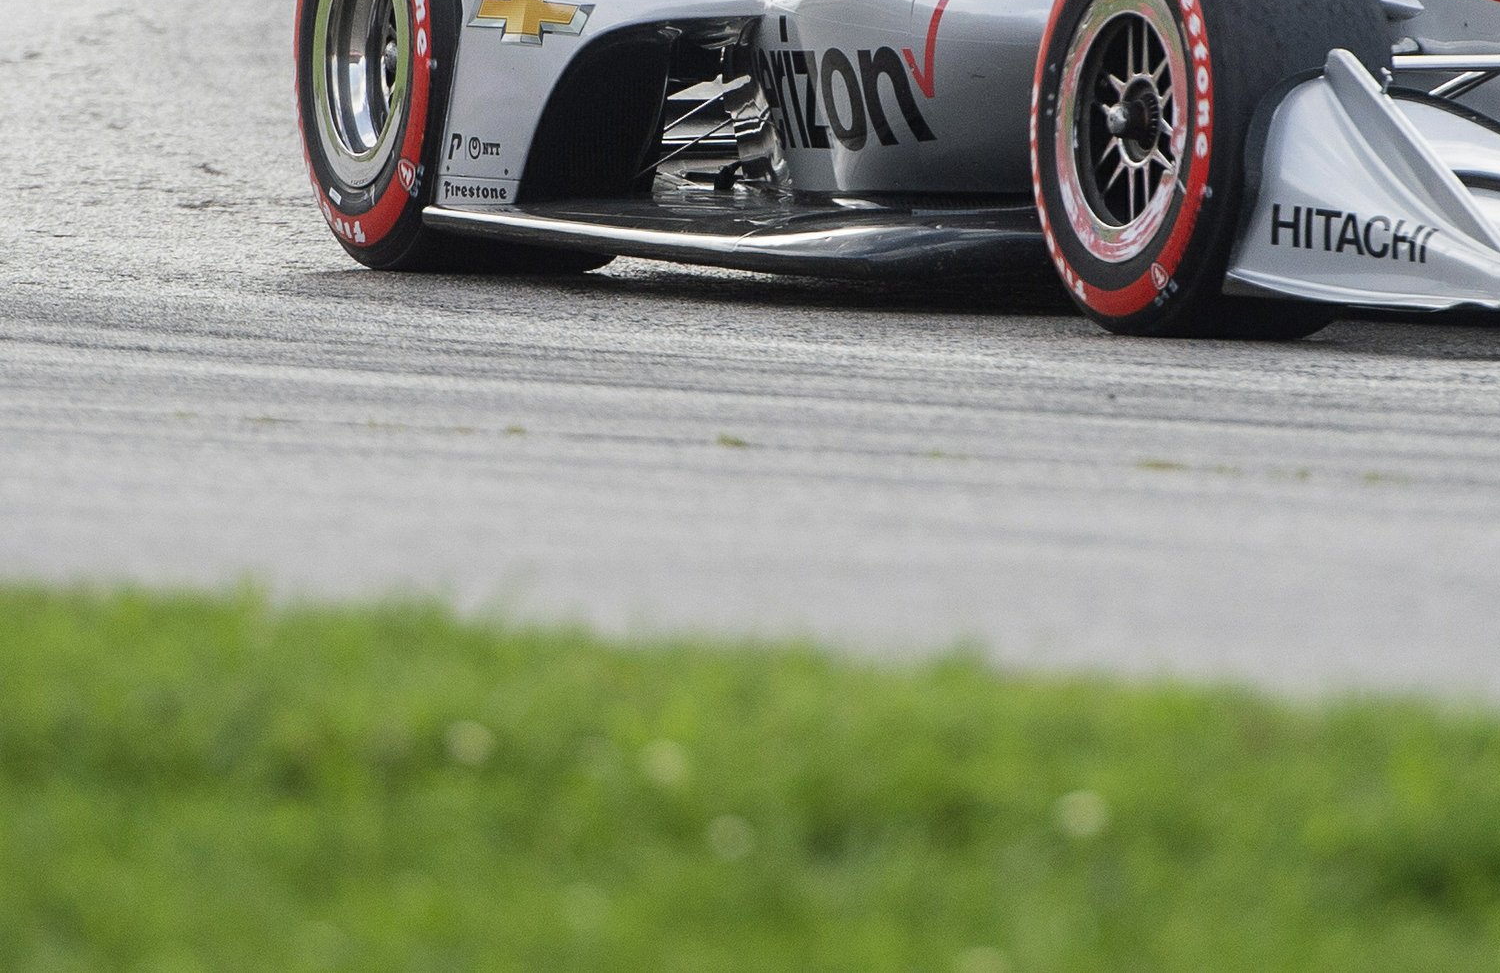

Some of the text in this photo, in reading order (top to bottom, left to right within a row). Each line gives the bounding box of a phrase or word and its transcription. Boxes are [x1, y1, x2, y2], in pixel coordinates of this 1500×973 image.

[757, 14, 938, 152] erizon
[482, 142, 501, 156] NTT
[443, 180, 508, 200] Firestone
[1271, 203, 1440, 264] HITACHI
